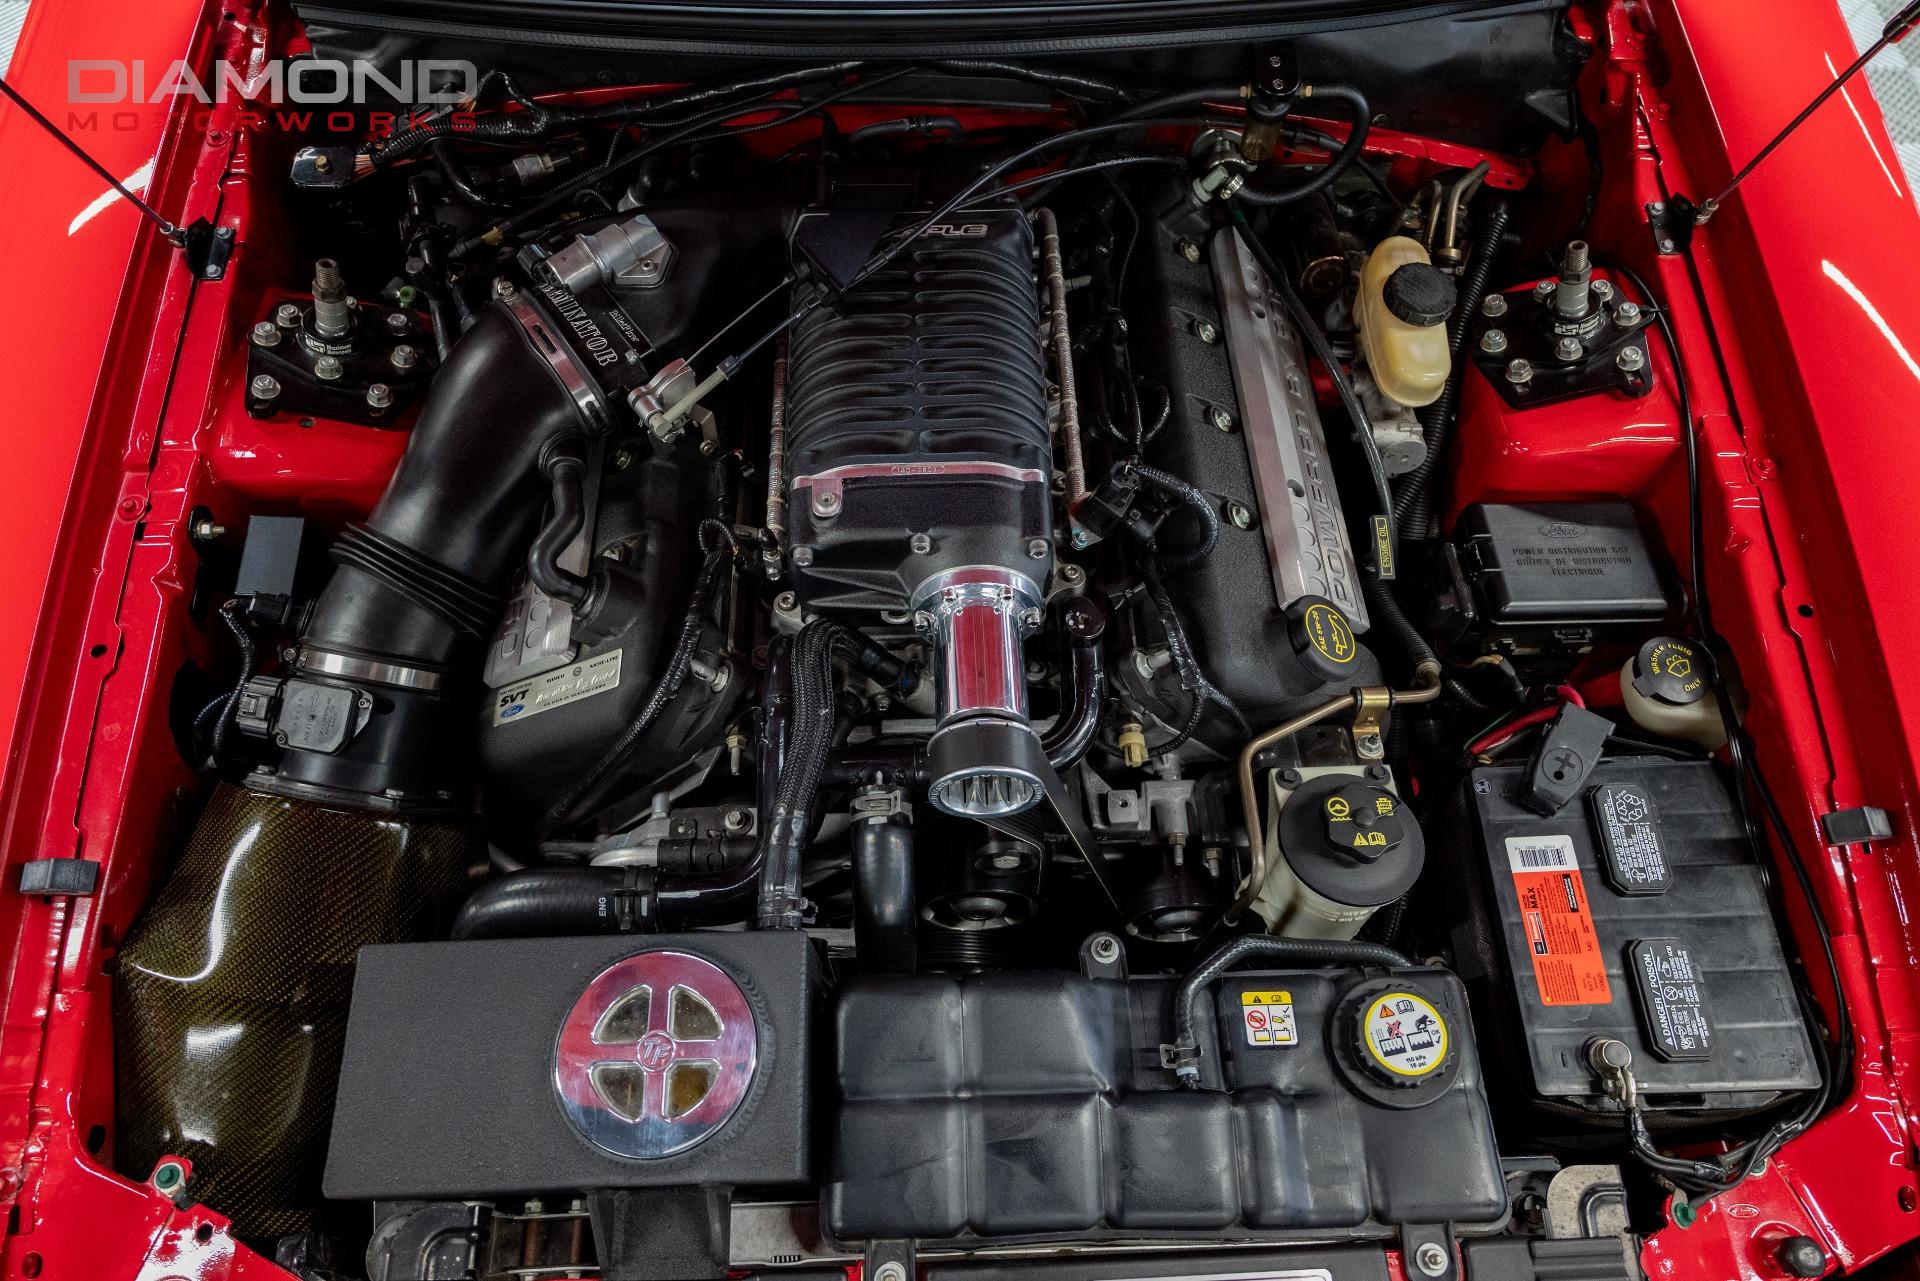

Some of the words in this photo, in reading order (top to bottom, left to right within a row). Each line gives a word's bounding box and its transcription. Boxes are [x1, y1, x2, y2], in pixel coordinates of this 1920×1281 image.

[1280, 344, 1302, 399] BY
[1298, 409, 1355, 610] POWERED
[1378, 525, 1388, 537] OIL
[1381, 539, 1391, 568] ENGINE
[1512, 547, 1544, 556] POWER
[1548, 546, 1607, 555] DISTRIBUTION
[1612, 546, 1629, 554] BOX
[1556, 557, 1569, 566] DE
[1572, 556, 1633, 566] DISTRIBUTION
[1311, 610, 1323, 635] 5W-20
[1318, 635, 1328, 650] SAE
[1650, 645, 1665, 675] WASHER
[1667, 643, 1692, 656] FLUID
[1684, 677, 1701, 692] ONLY
[499, 688, 530, 708] SVT
[599, 897, 607, 916] ENG
[1527, 887, 1539, 909] MAX
[1643, 953, 1659, 988] POISON
[1655, 997, 1671, 1037] DANGER
[643, 1039, 671, 1065] TF
